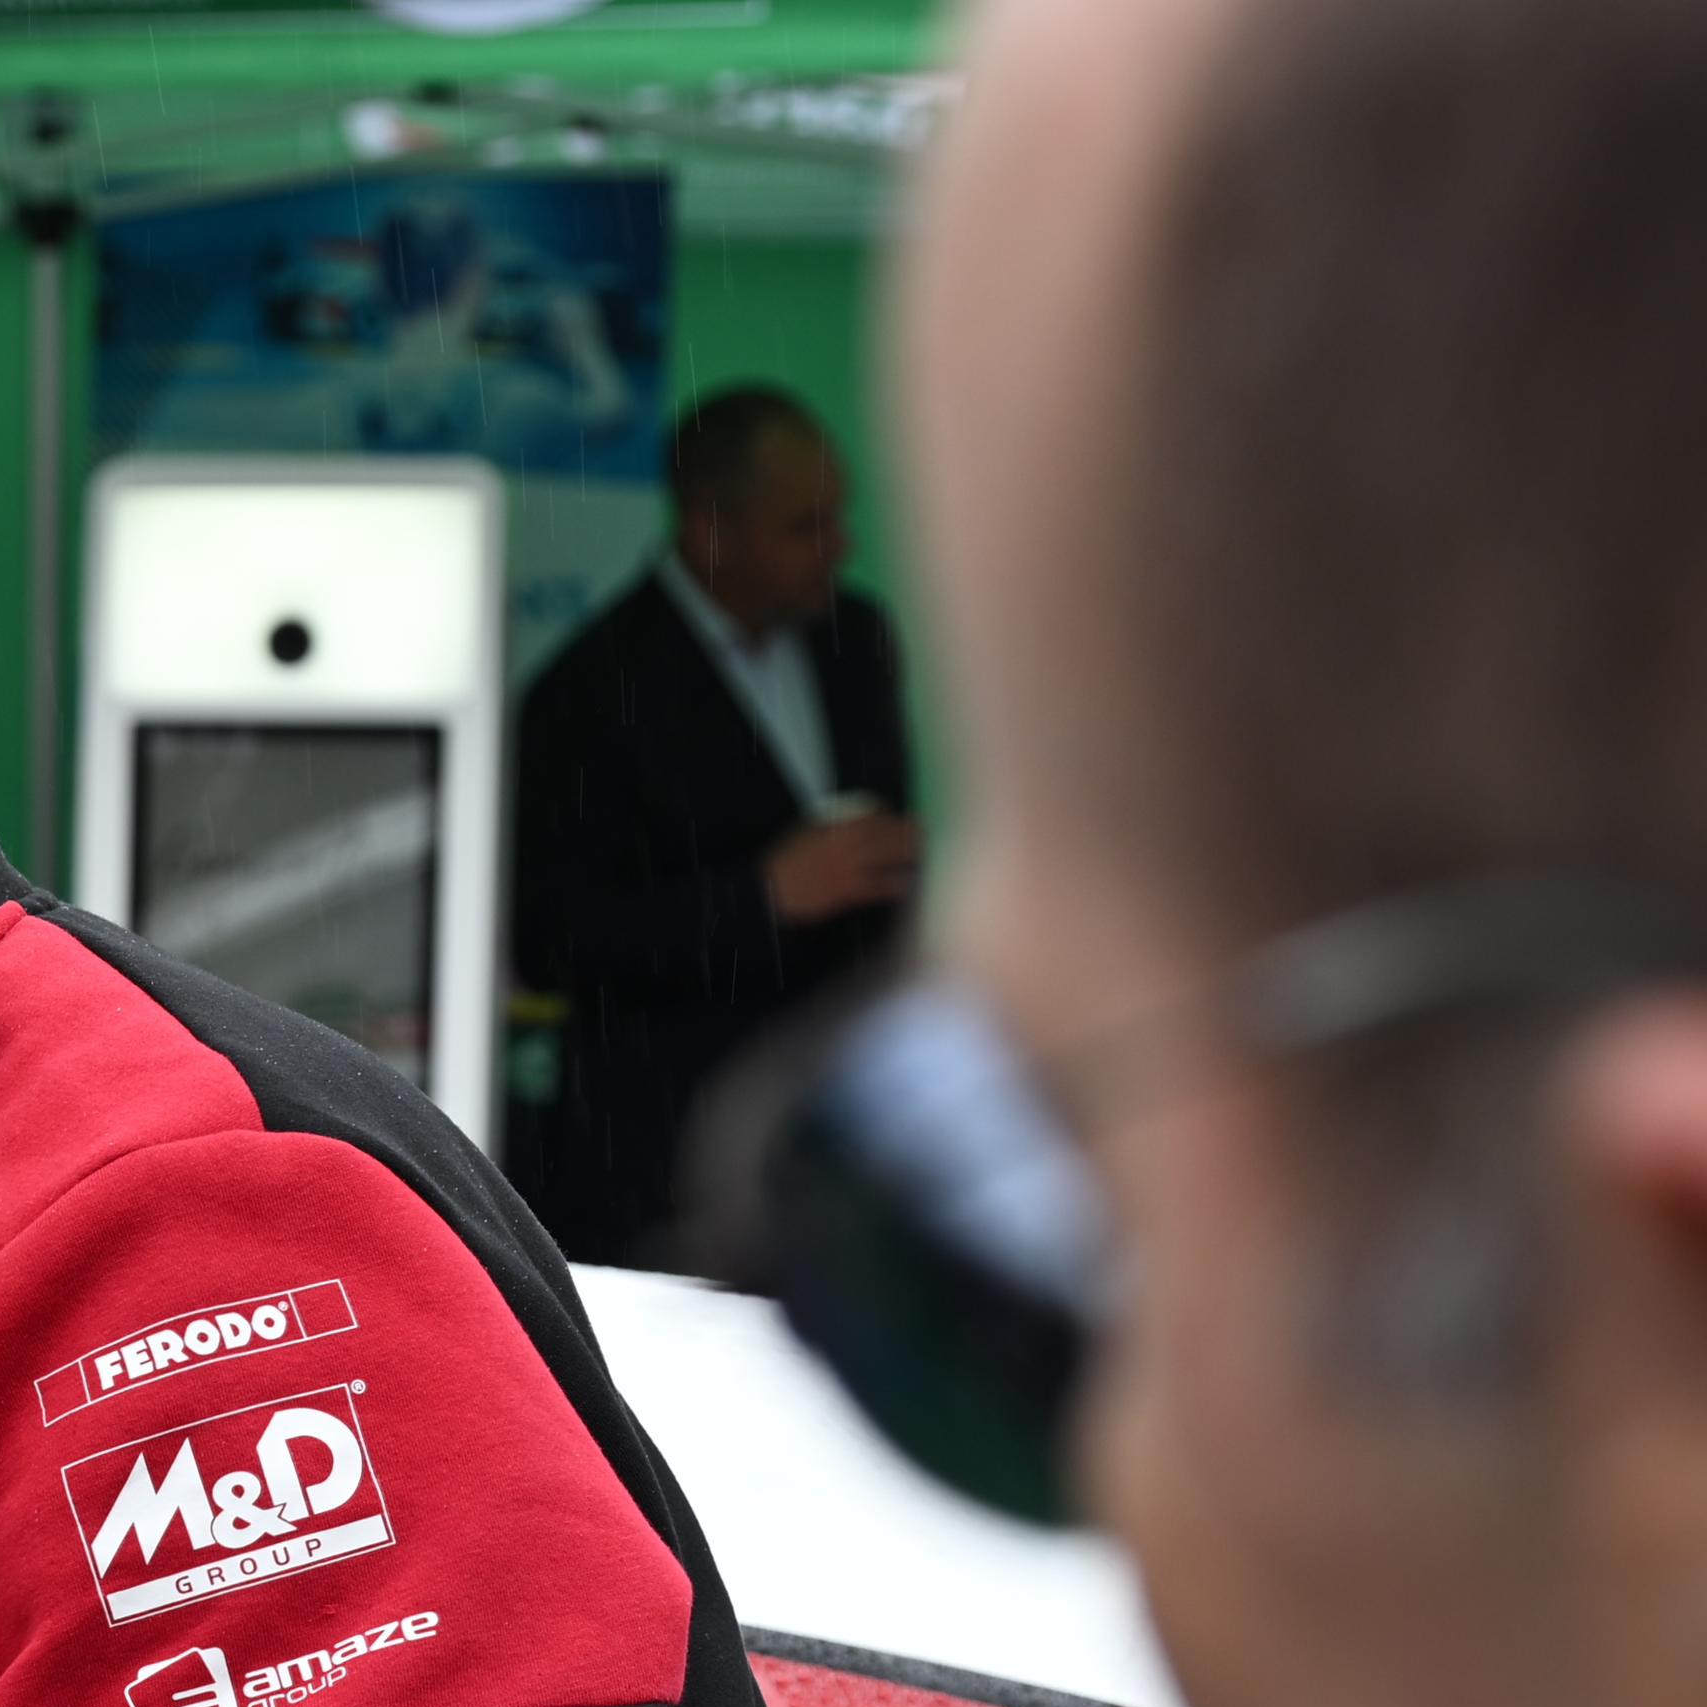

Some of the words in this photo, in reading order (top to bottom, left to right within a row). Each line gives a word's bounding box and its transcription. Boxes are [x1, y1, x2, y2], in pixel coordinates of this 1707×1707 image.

[93, 1303, 288, 1391] FERODO
[91, 1407, 363, 1580] M&D
[174, 1536, 324, 1596] GROUP
[242, 1610, 439, 1699] amaze
